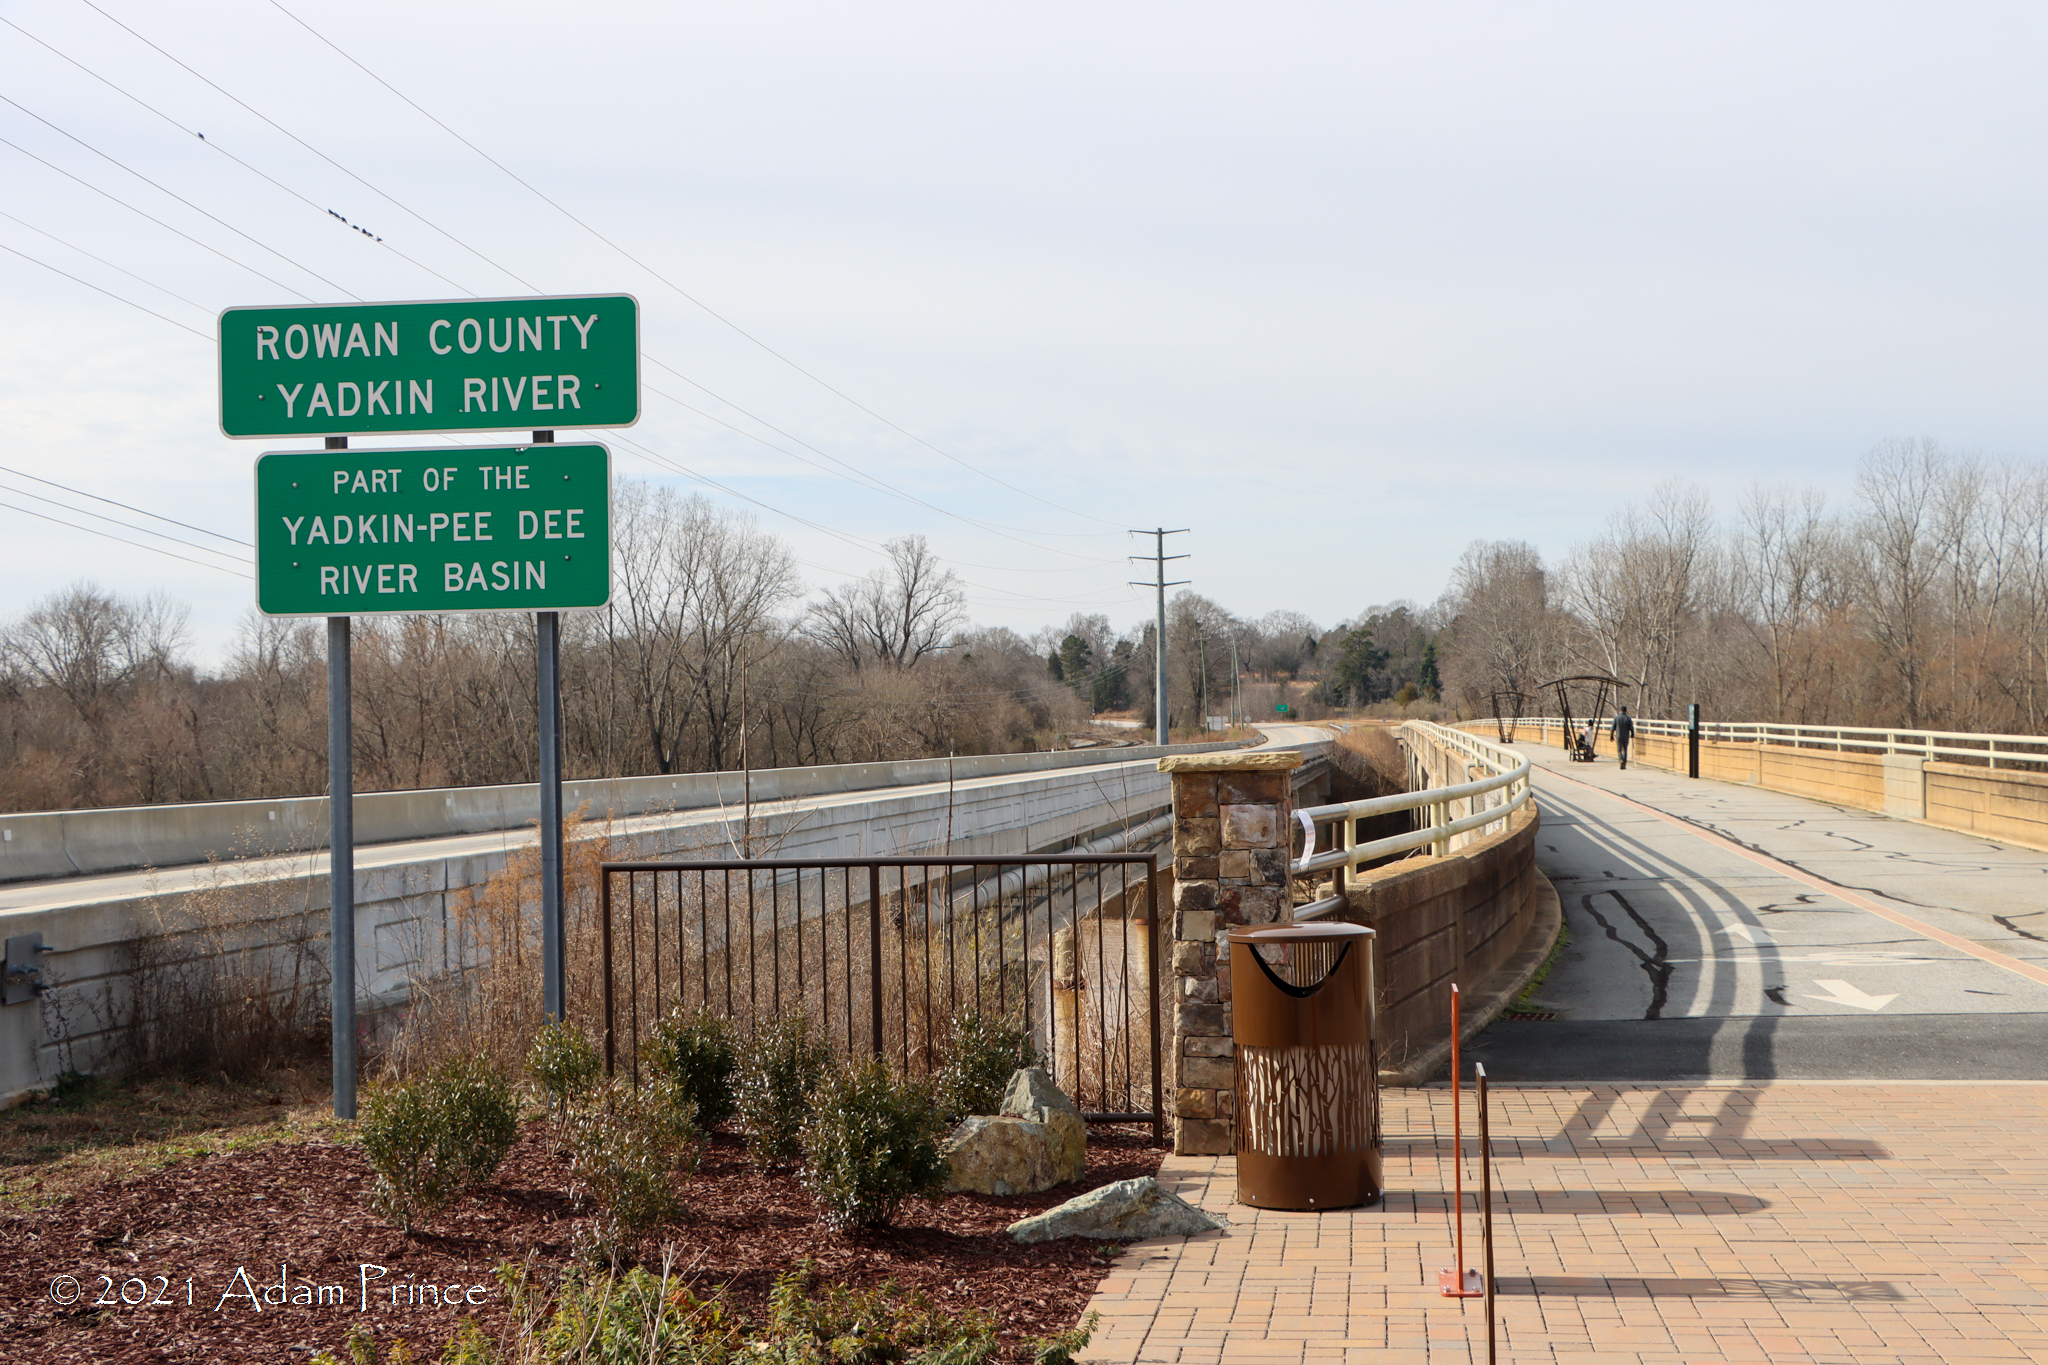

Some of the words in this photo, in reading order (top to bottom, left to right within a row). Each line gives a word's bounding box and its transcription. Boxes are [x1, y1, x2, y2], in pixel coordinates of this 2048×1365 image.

[256, 321, 400, 361] ROWAN
[429, 314, 599, 356] COUNTY
[276, 379, 434, 418] YADKIN
[464, 374, 581, 413] RIVER
[333, 469, 402, 494] PART
[423, 467, 458, 492] OF
[478, 466, 530, 490] THE
[282, 511, 493, 545] YADKIN-PEE
[518, 509, 585, 540] DEE
[320, 563, 418, 595] RIVER
[444, 560, 546, 592] BASIN
